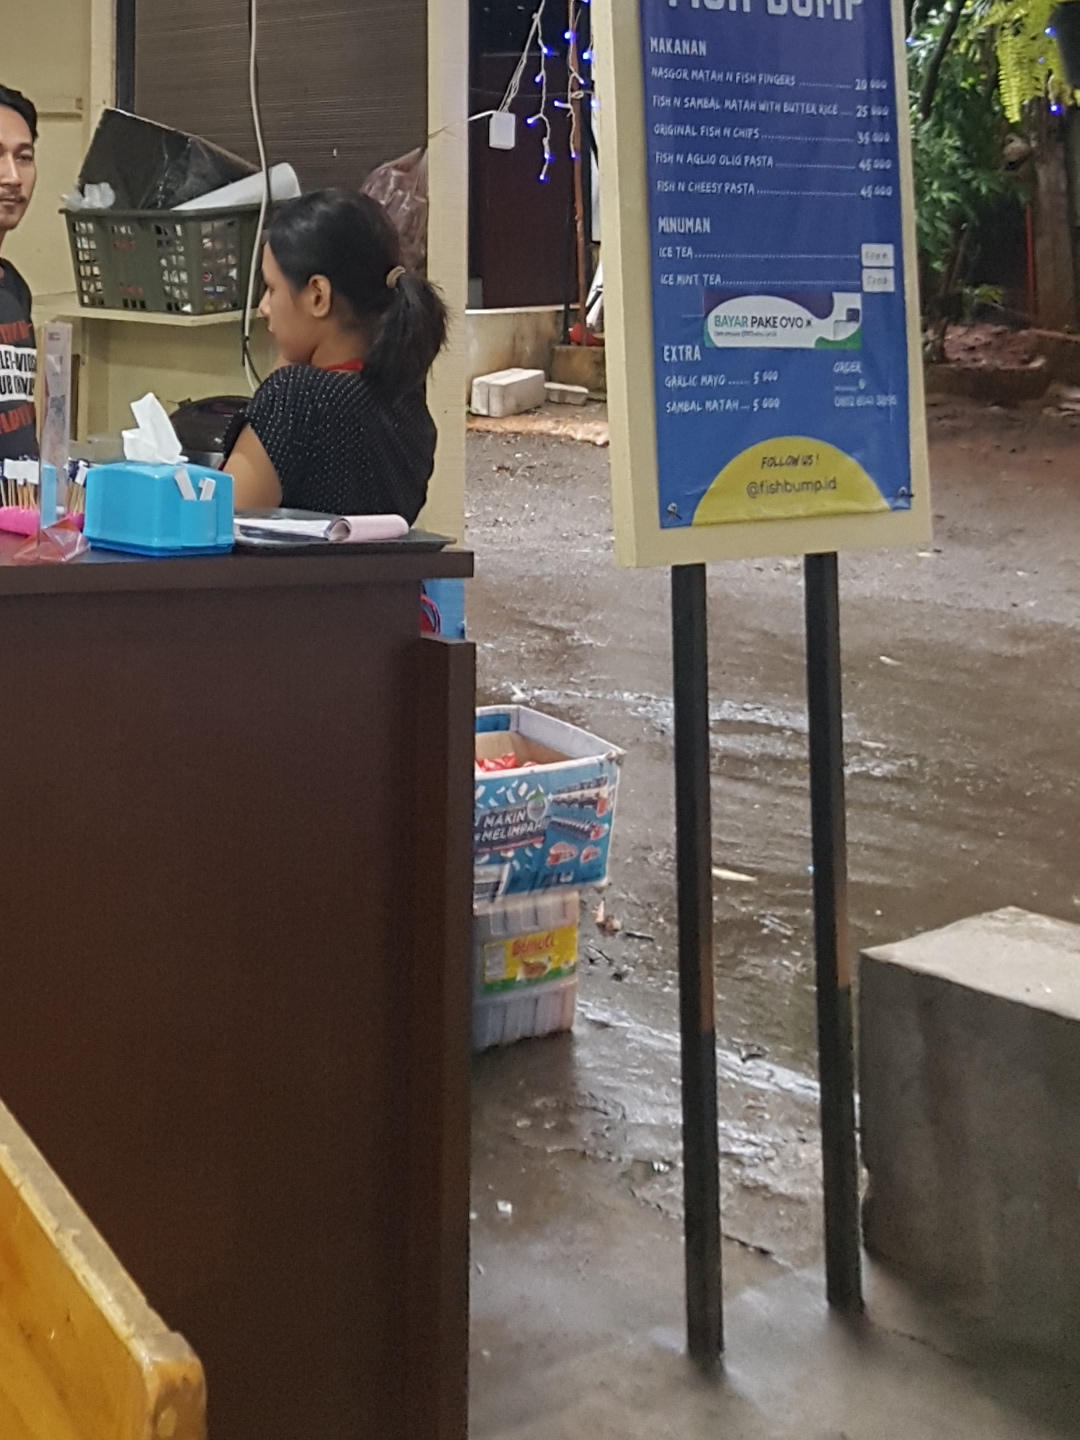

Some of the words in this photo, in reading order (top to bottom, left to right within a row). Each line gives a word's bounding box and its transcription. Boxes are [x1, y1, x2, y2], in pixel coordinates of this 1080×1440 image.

[650, 36, 707, 57] MAKANAN
[651, 67, 688, 81] NASGOR
[691, 69, 724, 83] MATAH
[736, 71, 757, 84] FISH
[758, 73, 796, 87] FINGERS
[653, 95, 670, 108] FISH
[684, 96, 721, 110] SAMBAL
[724, 98, 757, 112] MATAH
[758, 100, 780, 113] WITH
[783, 101, 817, 115] BUTTER
[654, 123, 697, 136] ORIGINAL
[701, 125, 720, 138] FISH
[733, 126, 760, 140] CHIPS
[655, 151, 673, 164] FISH
[686, 152, 717, 166] AGLIO
[720, 153, 742, 166] OLIO
[744, 154, 774, 168] PASTA
[656, 179, 675, 193] FISH
[688, 180, 722, 194] CHEESY
[724, 182, 755, 196] PASTA
[658, 216, 711, 235] MINUMAN
[659, 246, 673, 258] ICE
[676, 246, 694, 259] TEA
[660, 273, 674, 286] ICE
[676, 273, 700, 286] MINT
[703, 274, 722, 286] TEA
[714, 315, 749, 328] BAYAR
[750, 315, 778, 329] PAKE
[779, 316, 804, 329] OVO
[663, 345, 702, 362] EXTRA
[664, 374, 698, 388] GARLIC
[701, 372, 726, 387] MAYO
[666, 400, 703, 414] SAMBAL
[705, 398, 739, 412] MATAH
[761, 454, 800, 469] FOLLOW
[746, 477, 838, 499] @fishbump.id
